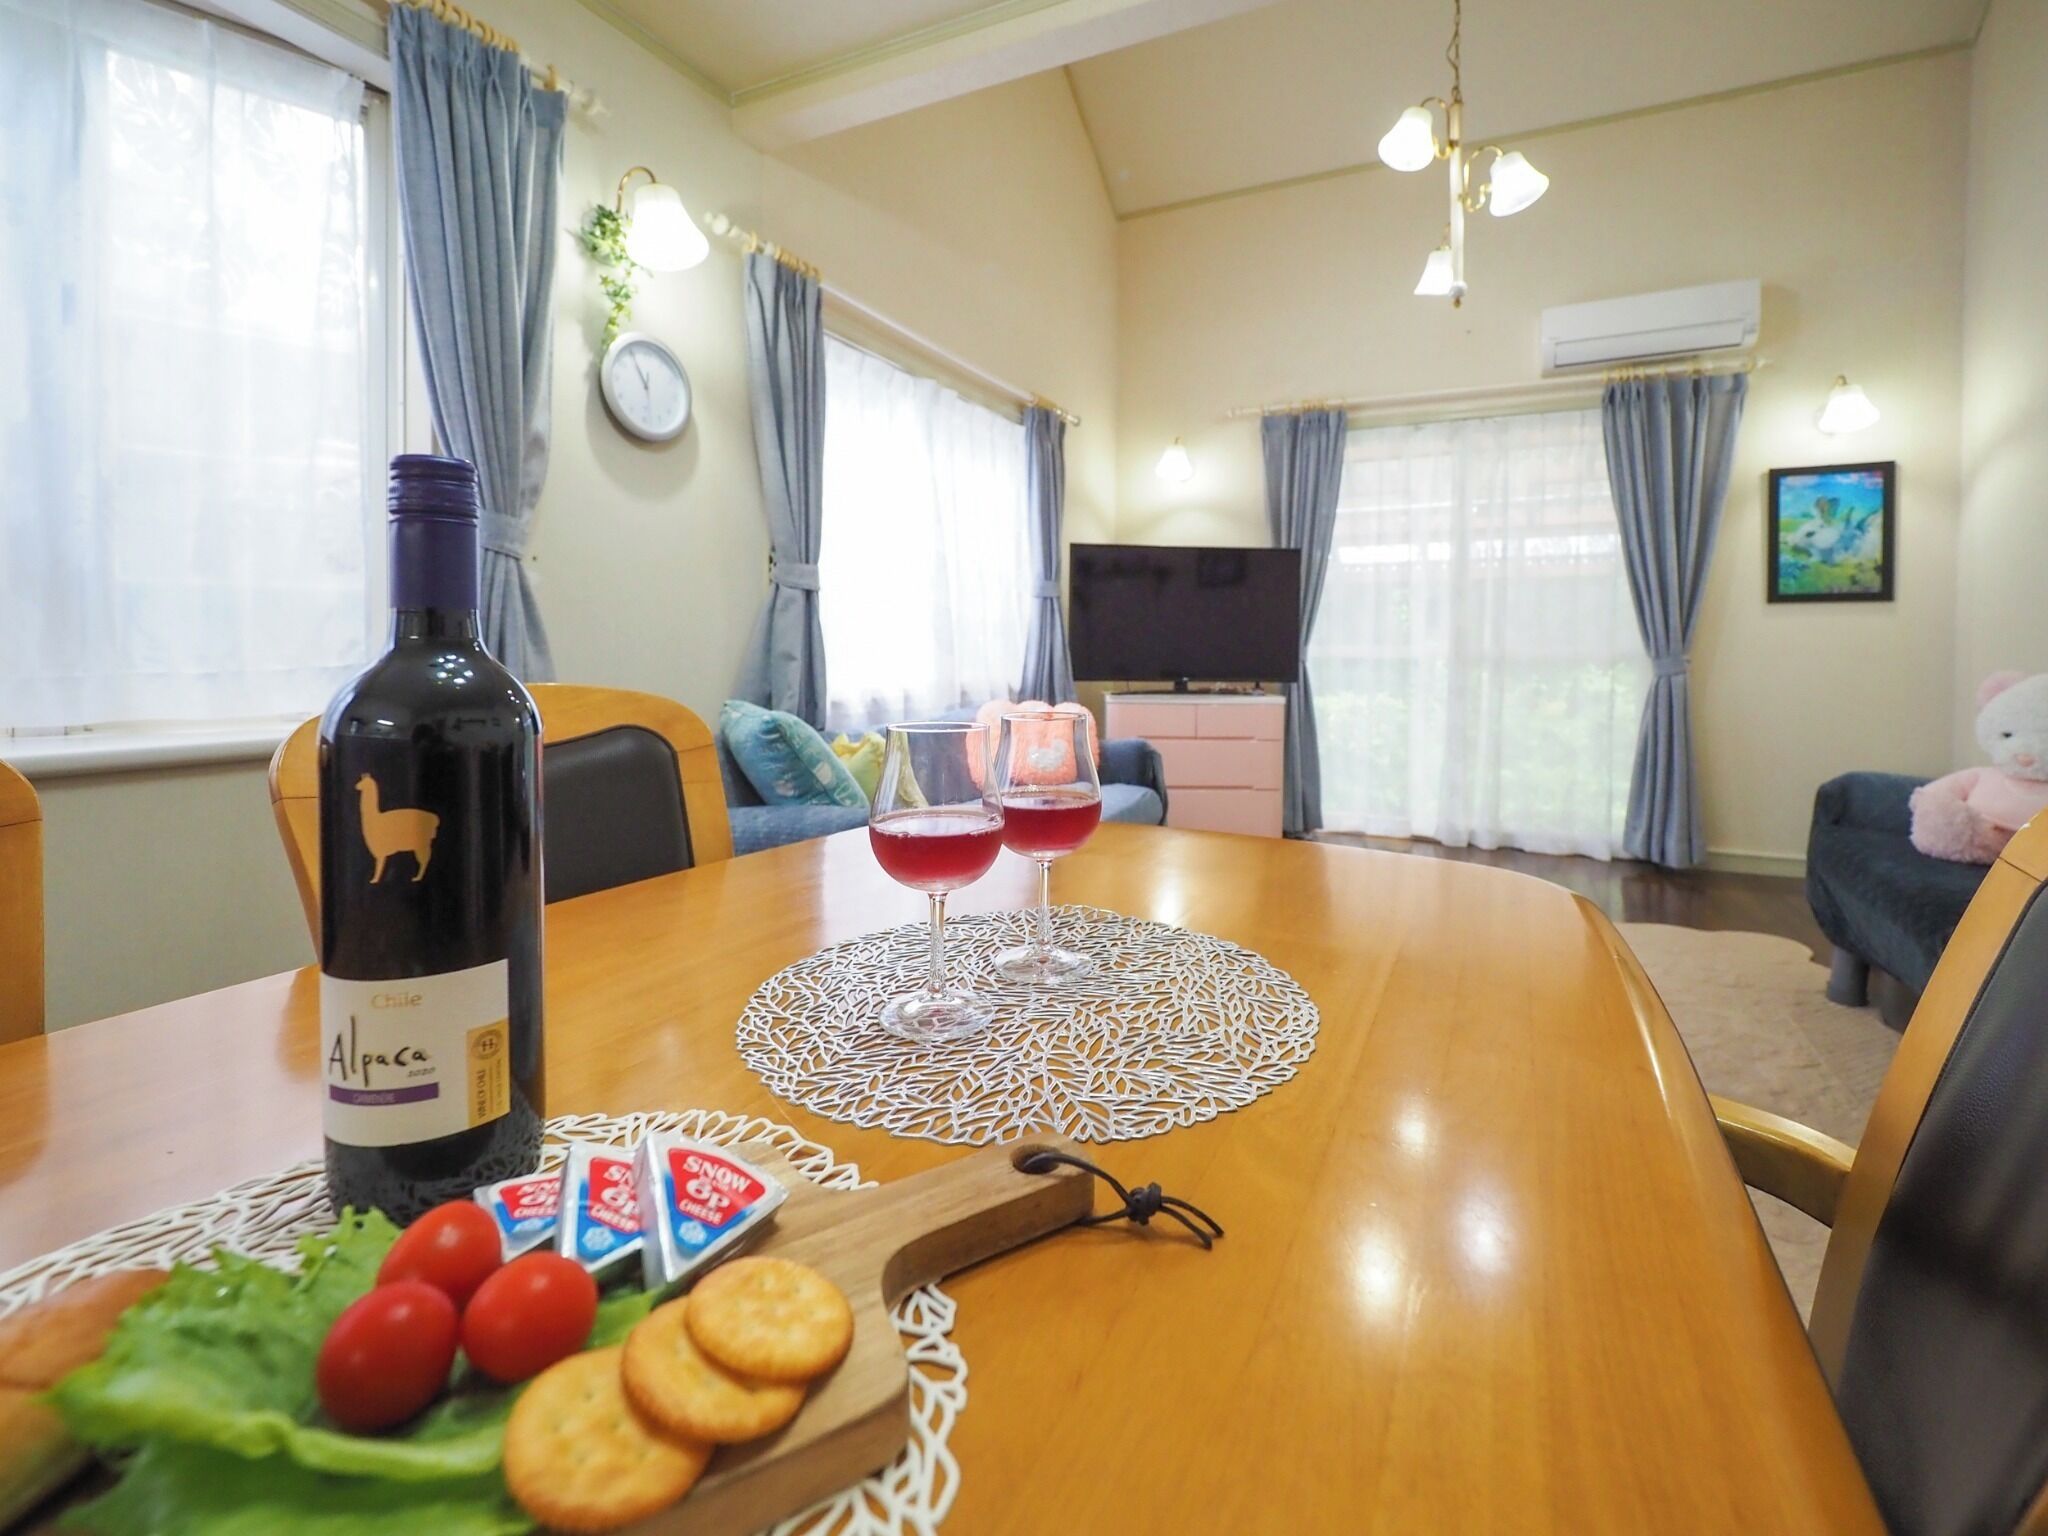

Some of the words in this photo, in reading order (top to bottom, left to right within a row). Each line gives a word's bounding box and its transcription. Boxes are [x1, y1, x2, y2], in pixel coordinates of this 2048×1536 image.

[371, 992, 423, 1009] Chile
[329, 1015, 427, 1087] Alpaca
[683, 1155, 752, 1194] SNOW
[679, 1199, 723, 1225] CHEESE
